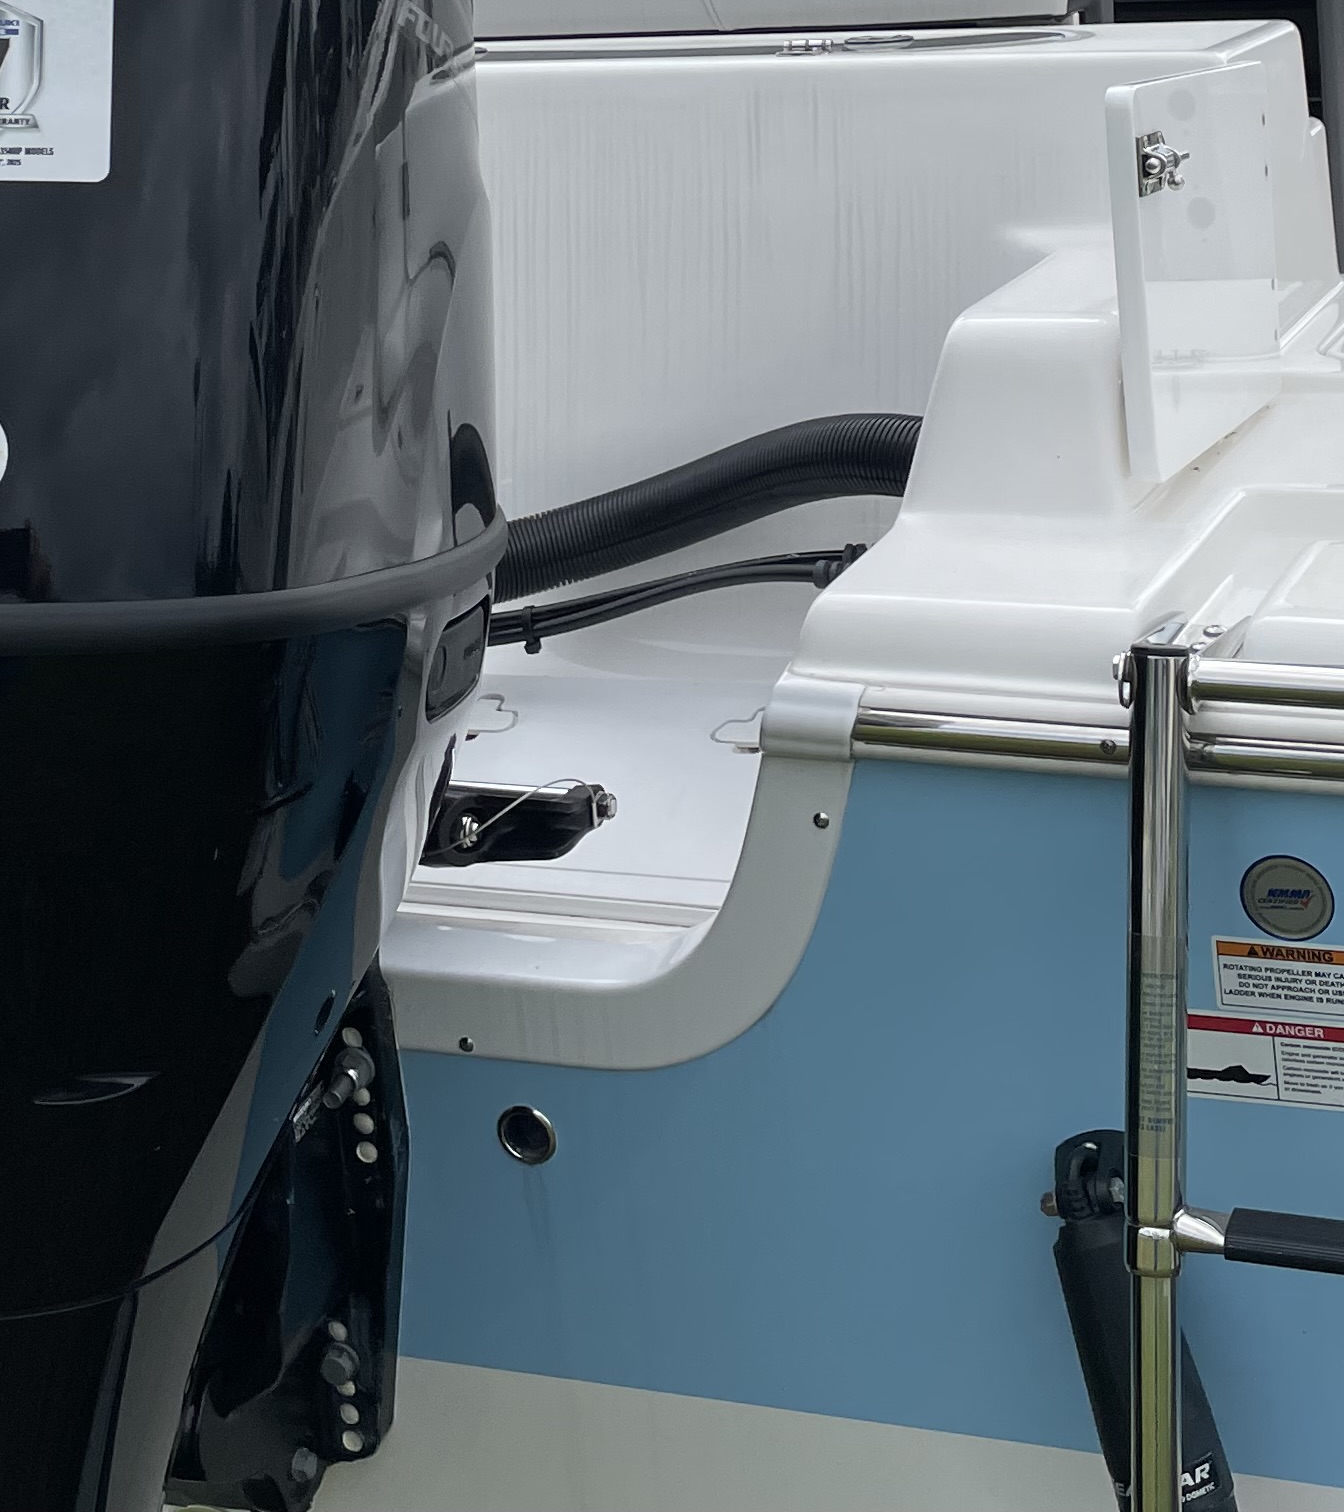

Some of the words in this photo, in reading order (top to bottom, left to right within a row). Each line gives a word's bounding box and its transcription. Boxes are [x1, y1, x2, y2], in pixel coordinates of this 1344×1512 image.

[1260, 945, 1334, 963] WARNING
[1223, 963, 1263, 974] ROTATING
[1264, 966, 1313, 978] PROPELLER
[1314, 971, 1331, 979] MAY
[1237, 973, 1273, 982] SERIOUS
[1274, 975, 1303, 985] INJURY
[1305, 978, 1317, 986] OR
[1224, 988, 1256, 998] LADDER
[1258, 991, 1282, 1000] WHEN
[1284, 993, 1314, 1003] ENGINE
[1238, 981, 1251, 989] DO
[1252, 982, 1268, 990] NOT
[1271, 984, 1316, 995] APPROACH
[1317, 988, 1330, 996] OR
[1265, 1023, 1325, 1039] DANGER
